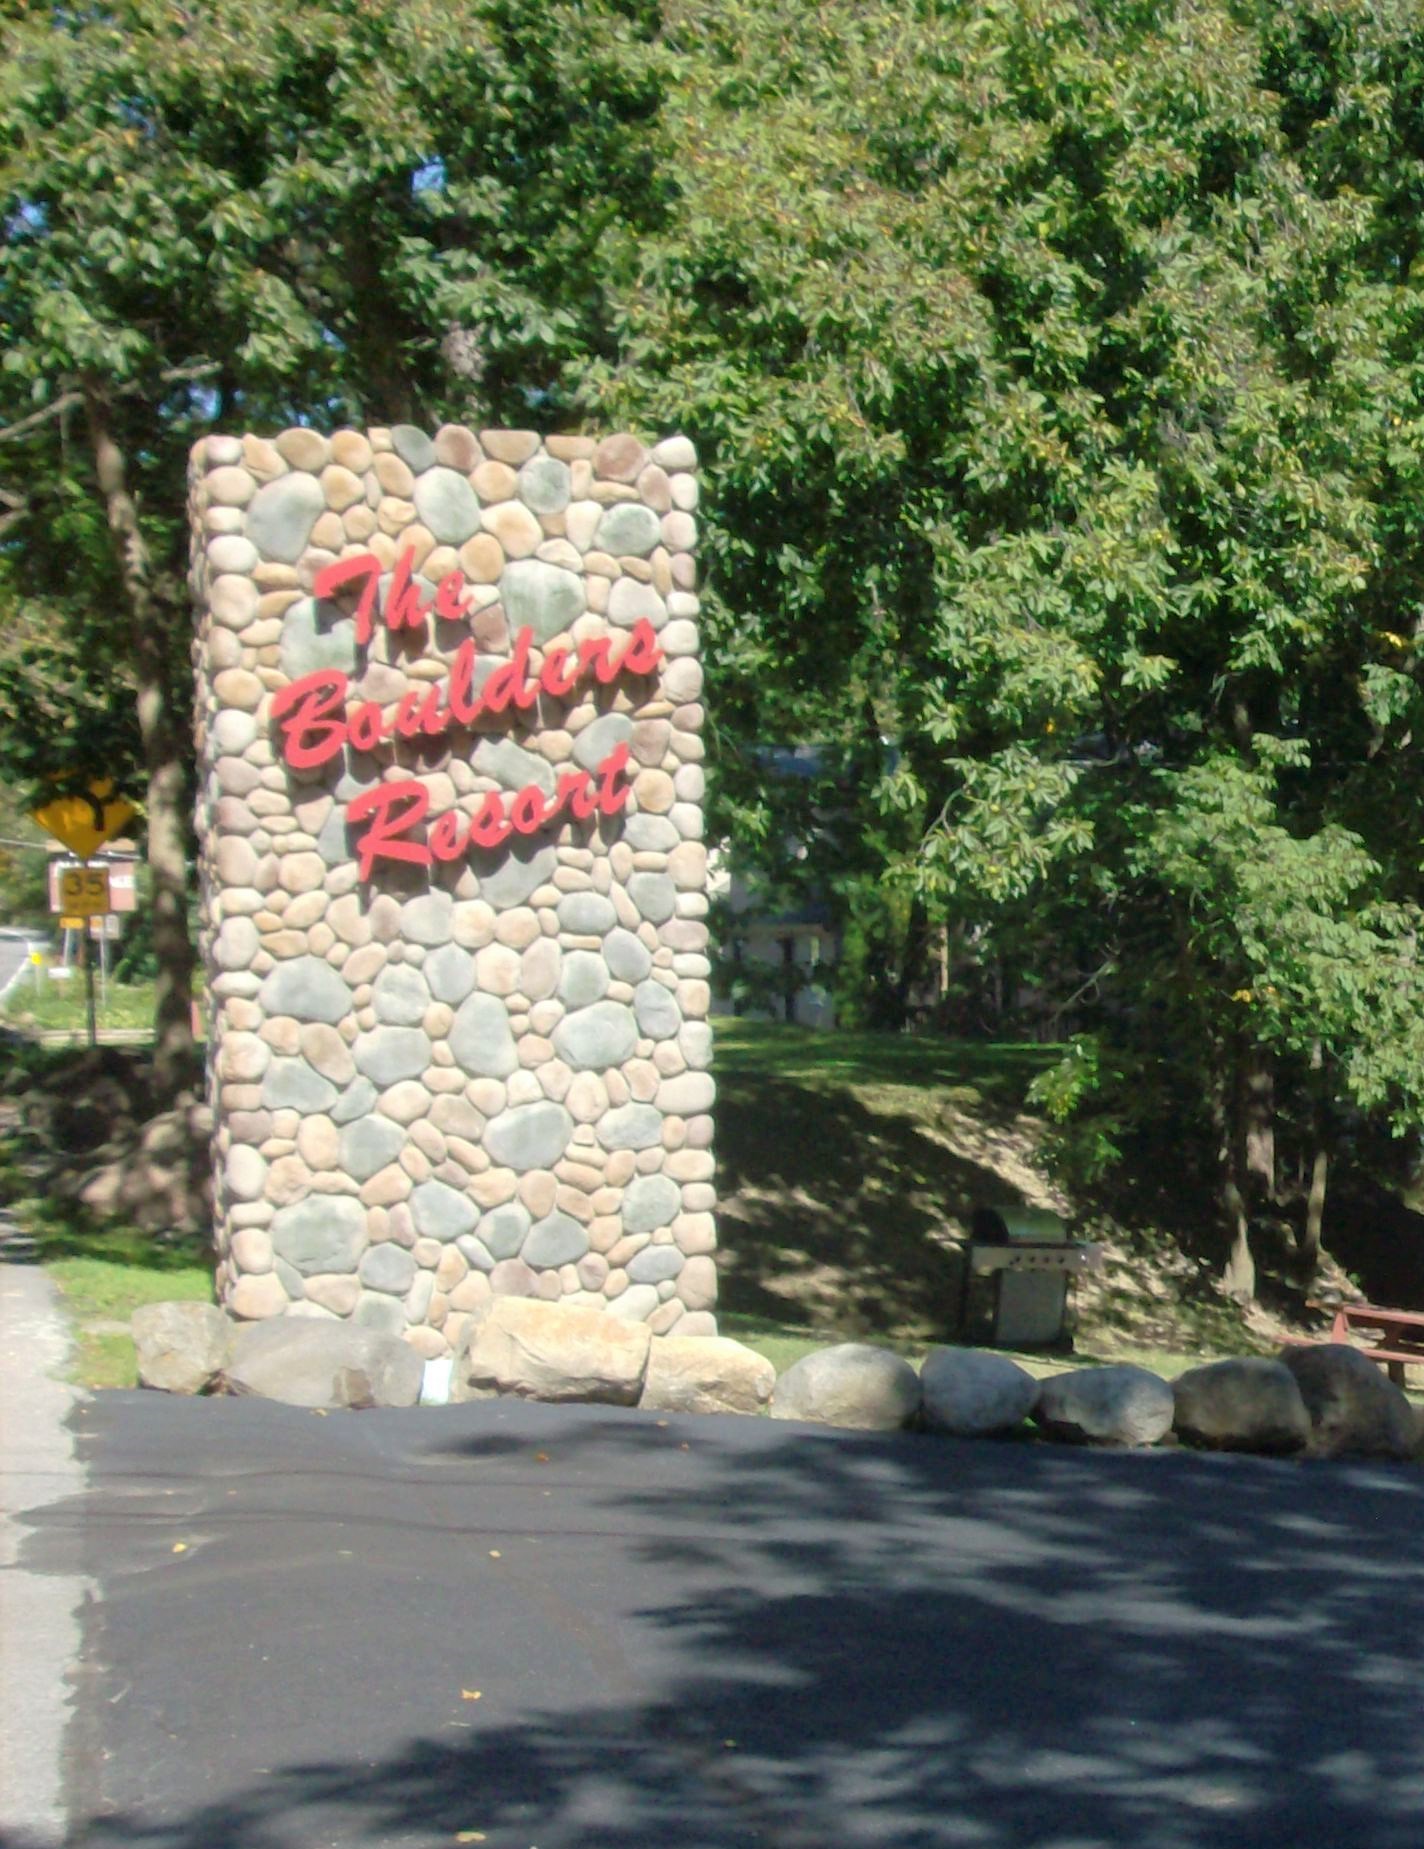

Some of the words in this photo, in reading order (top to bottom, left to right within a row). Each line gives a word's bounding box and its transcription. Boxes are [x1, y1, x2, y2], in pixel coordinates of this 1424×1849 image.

[315, 545, 474, 644] The
[271, 617, 664, 768] Boulders
[347, 741, 631, 882] Resort
[65, 872, 105, 896] 35
